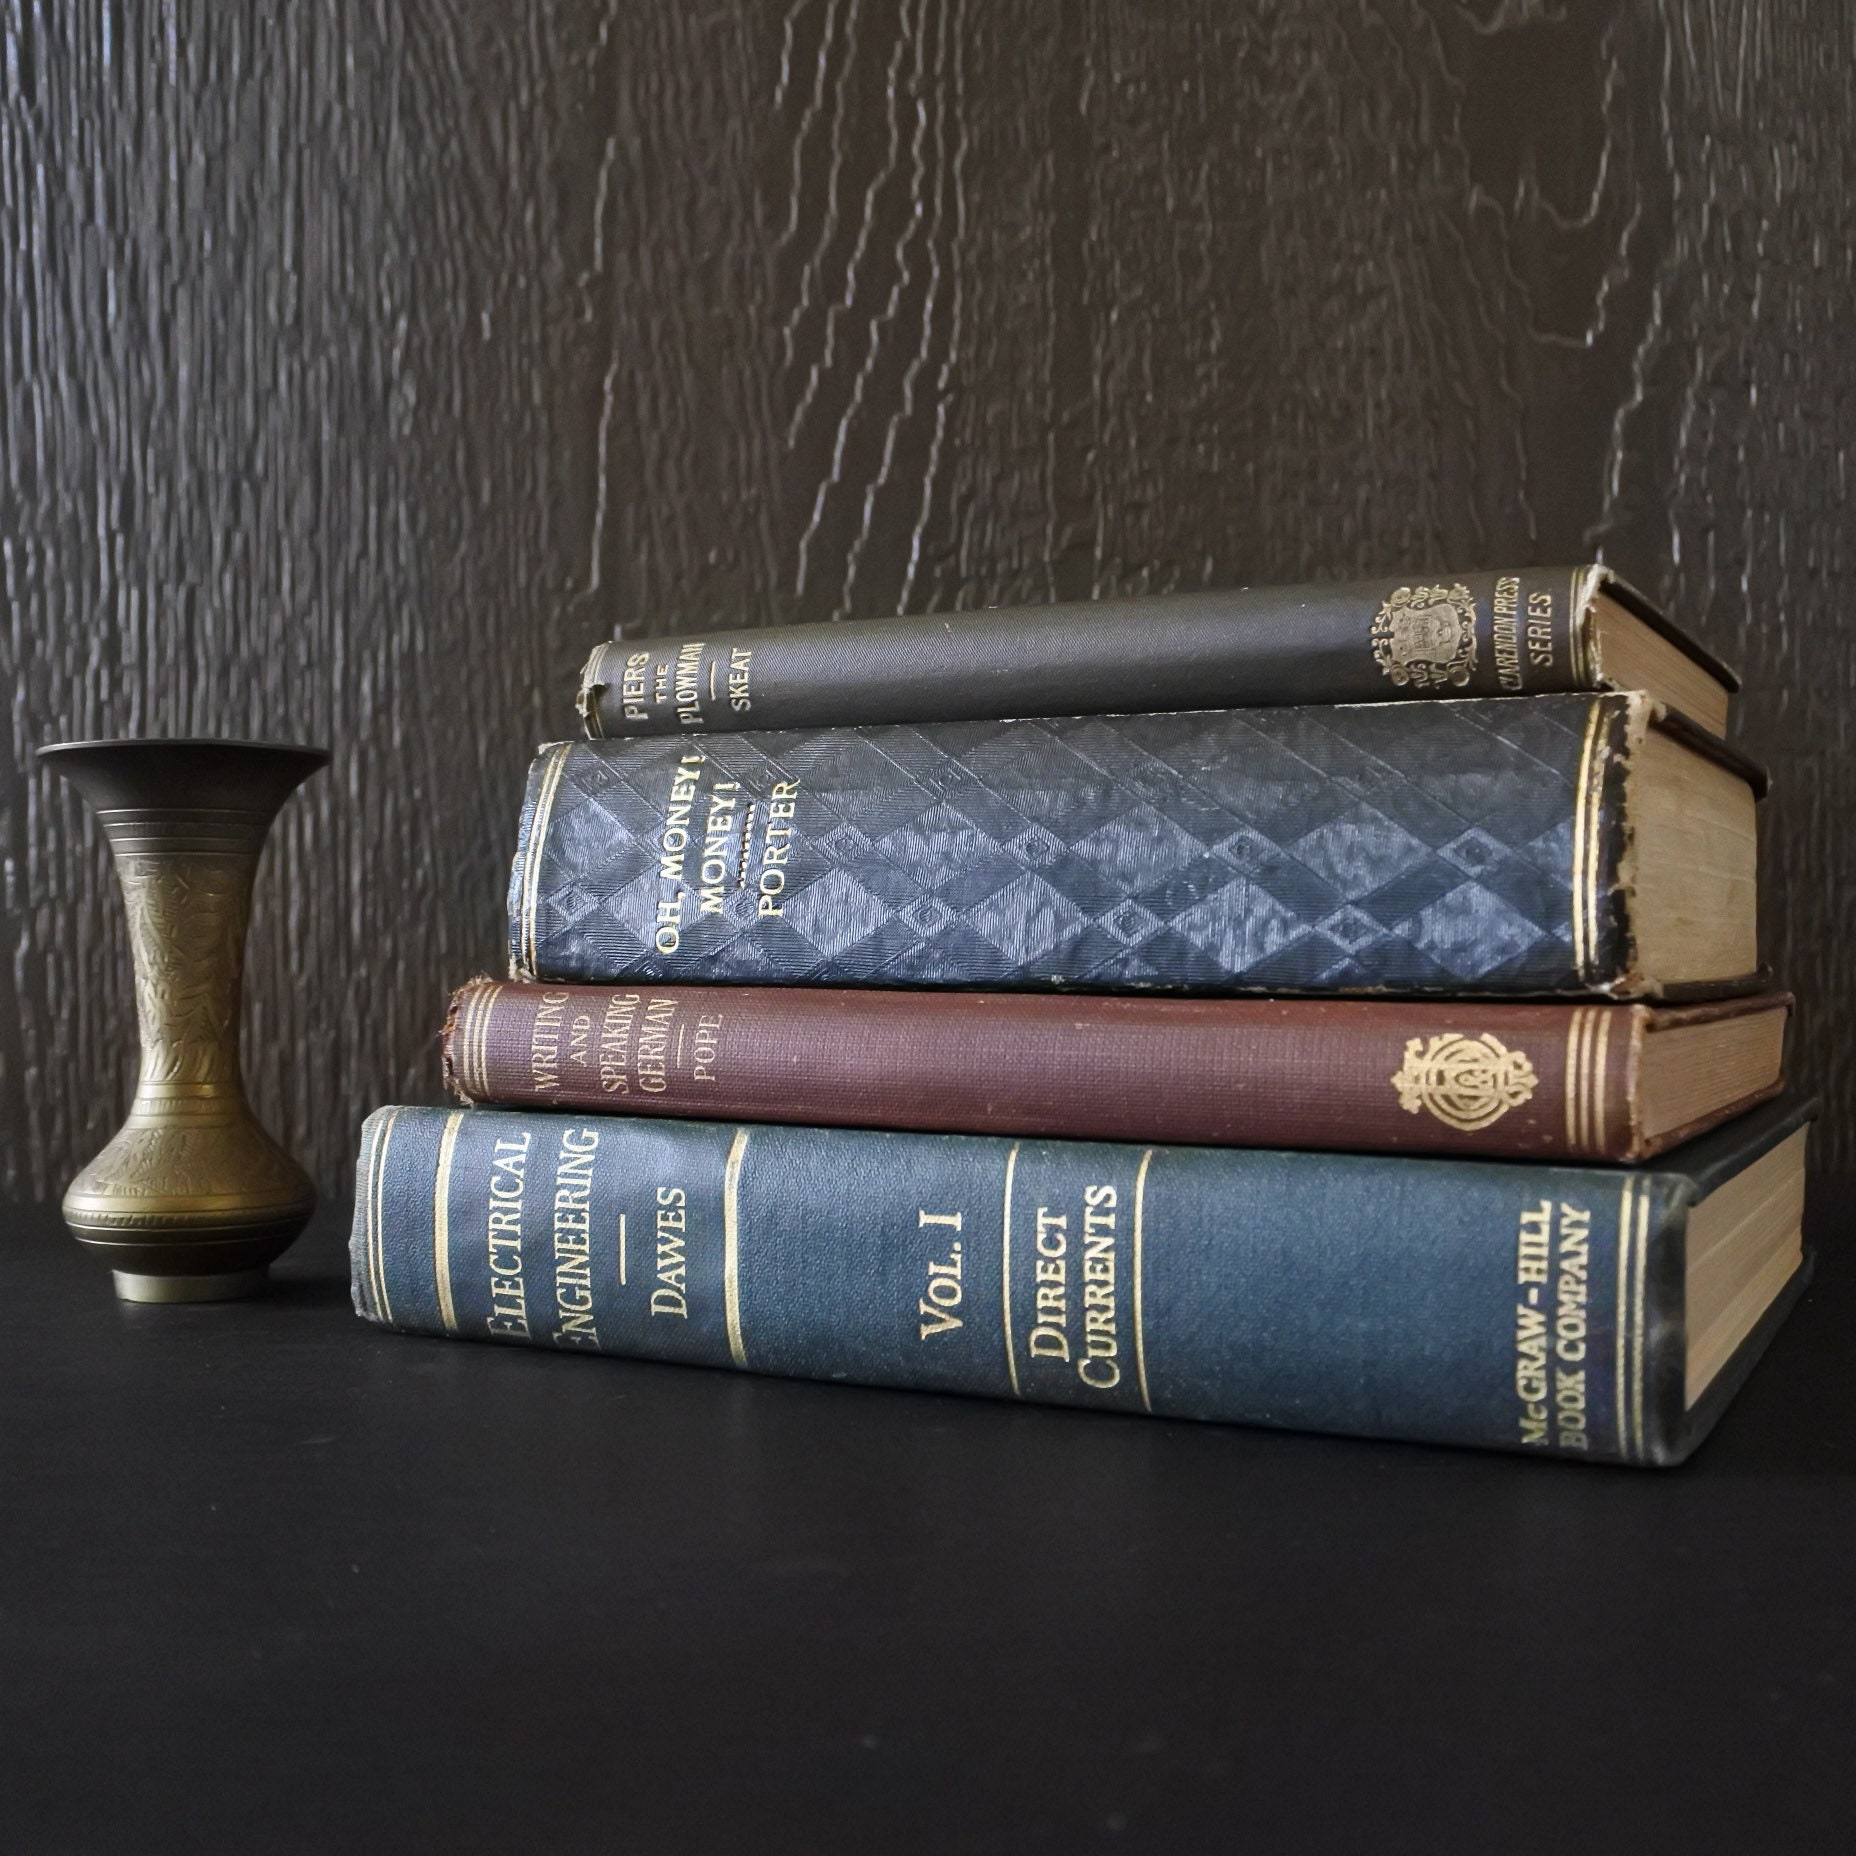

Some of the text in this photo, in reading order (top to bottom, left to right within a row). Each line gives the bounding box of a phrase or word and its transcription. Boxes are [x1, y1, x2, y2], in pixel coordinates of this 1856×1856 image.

[622, 652, 649, 720] PIERS
[655, 664, 669, 703] THE
[675, 642, 705, 724] PLOWMAN
[728, 648, 752, 712] SKEAT
[1494, 577, 1522, 690] CLARENDON PRESS
[1528, 592, 1553, 667] SERIES
[655, 755, 706, 955] OH, MONEY!
[700, 781, 740, 914] MONEY!
[758, 778, 800, 917] PORTER
[532, 992, 569, 1092] WRITING
[570, 1015, 590, 1067] AND
[600, 994, 640, 1094] SPEAKING
[638, 999, 678, 1092] GERMAN
[693, 1014, 723, 1082] POPE
[487, 1132, 531, 1340] ELECTRICAL
[553, 1128, 600, 1348] ENGINEERING
[651, 1187, 688, 1319] DAWES
[918, 1210, 963, 1341] VOL. I
[1029, 1207, 1069, 1363] DIRECT
[1077, 1185, 1121, 1388] CURRENTS
[1555, 1202, 1591, 1450] BOOK COMPANY
